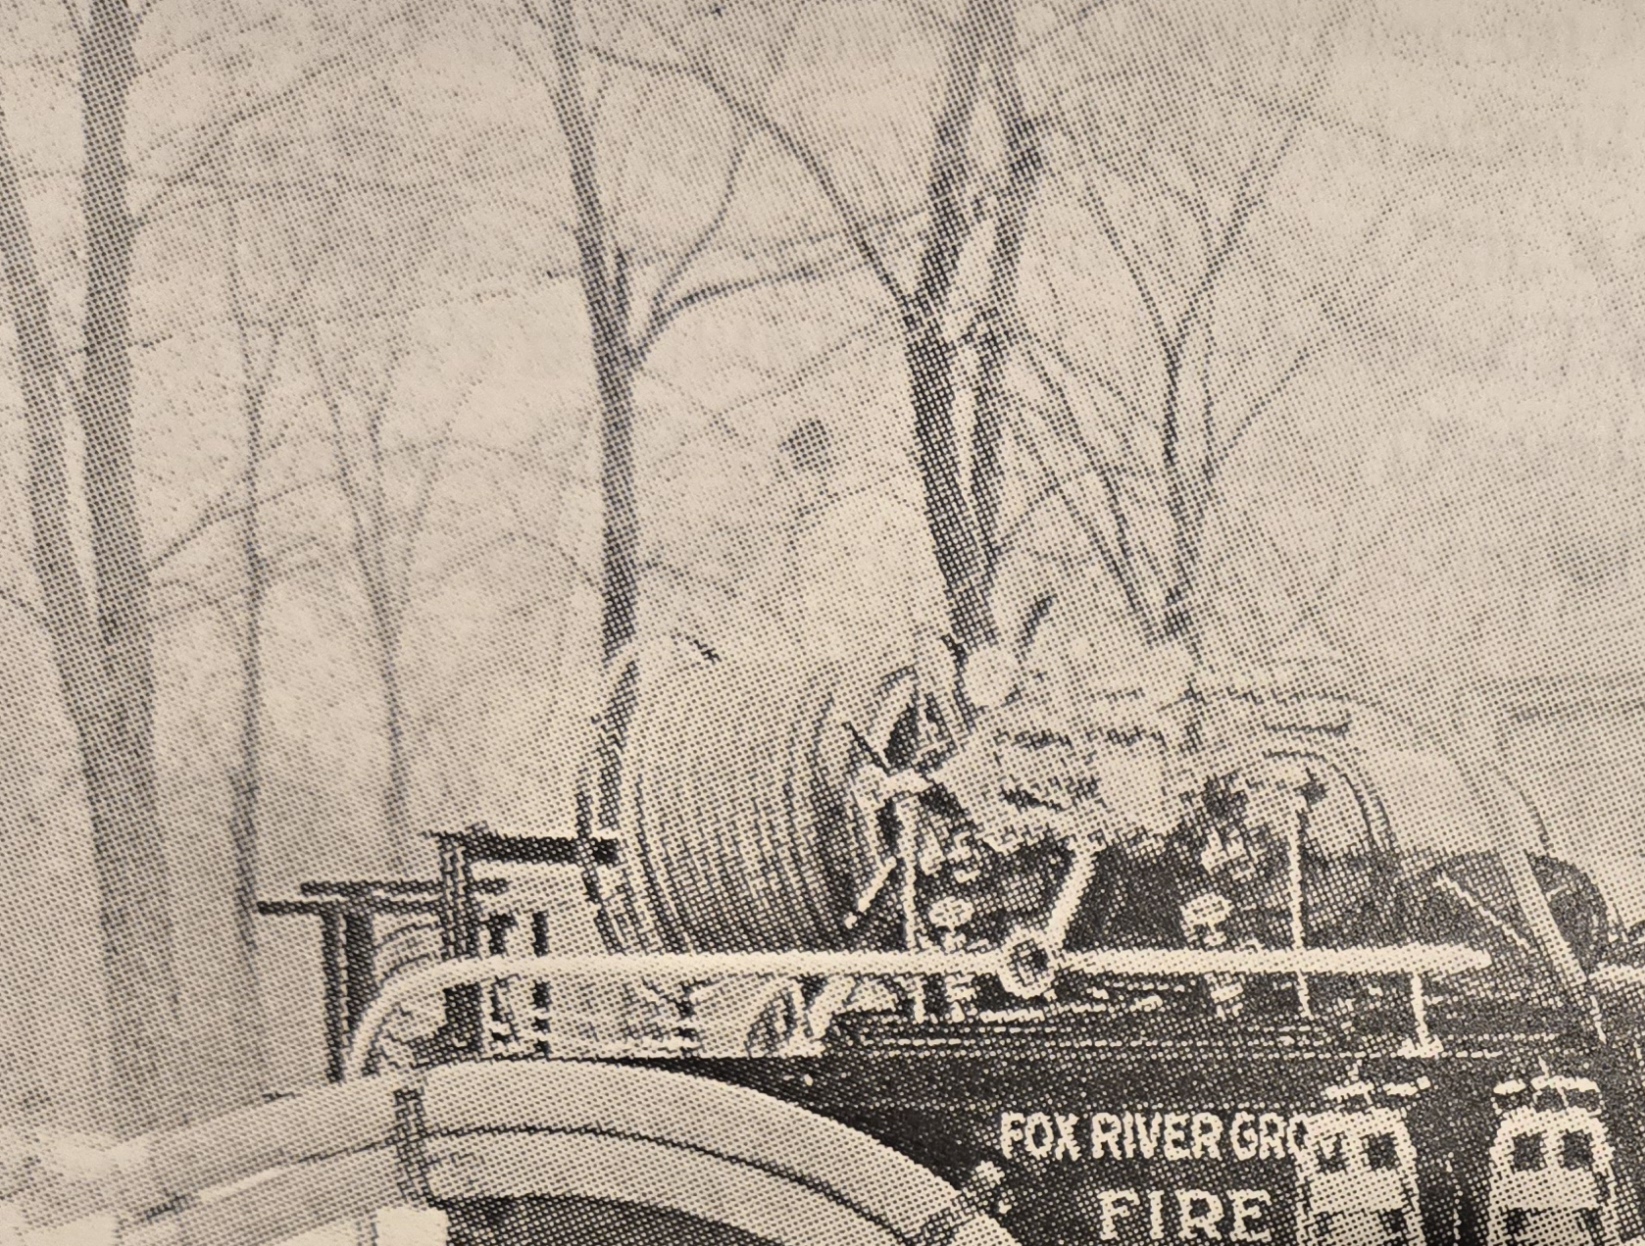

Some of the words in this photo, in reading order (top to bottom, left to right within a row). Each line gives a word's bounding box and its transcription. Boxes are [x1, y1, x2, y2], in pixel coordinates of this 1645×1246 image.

[999, 1111, 1080, 1161] FOX
[1091, 1111, 1223, 1162] RIVER
[1228, 1112, 1312, 1162] GRO
[1098, 1188, 1274, 1242] FIRE
